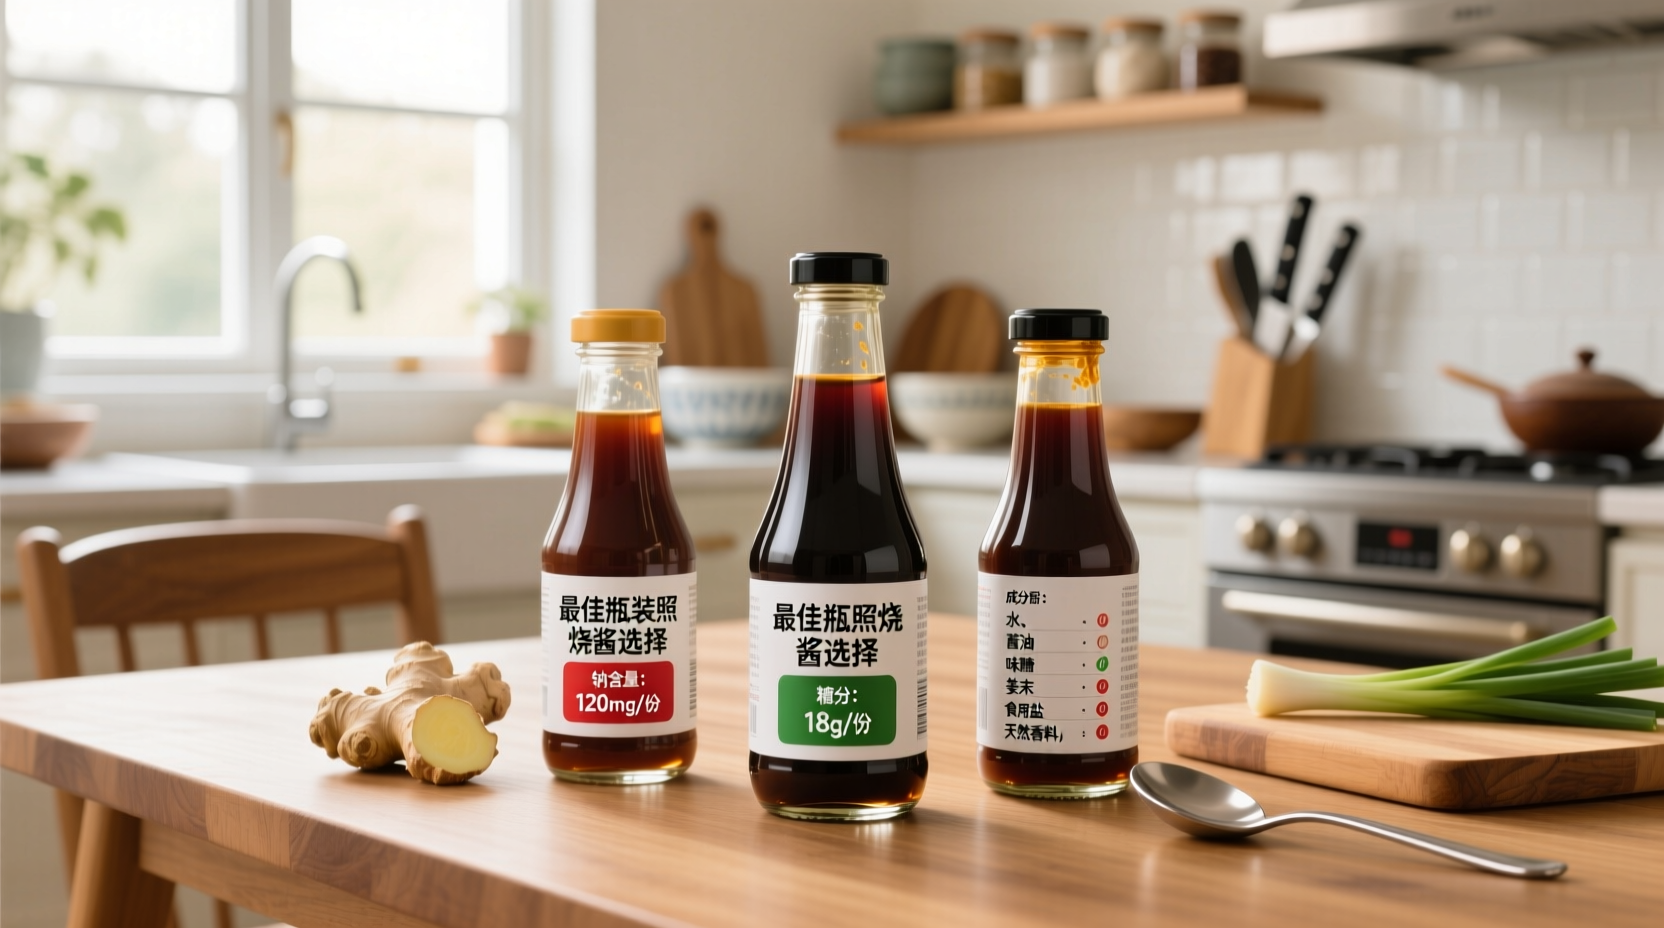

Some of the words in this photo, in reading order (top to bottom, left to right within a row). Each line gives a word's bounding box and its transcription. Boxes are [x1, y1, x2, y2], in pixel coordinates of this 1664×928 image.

[560, 596, 677, 624] 最佳瓶装照
[774, 602, 903, 633] 最佳瓶照烧
[569, 626, 667, 655] 烧酱选择
[797, 637, 878, 667] 酱选择
[576, 693, 660, 716] 120mg/份
[805, 712, 871, 738] 18g/份
